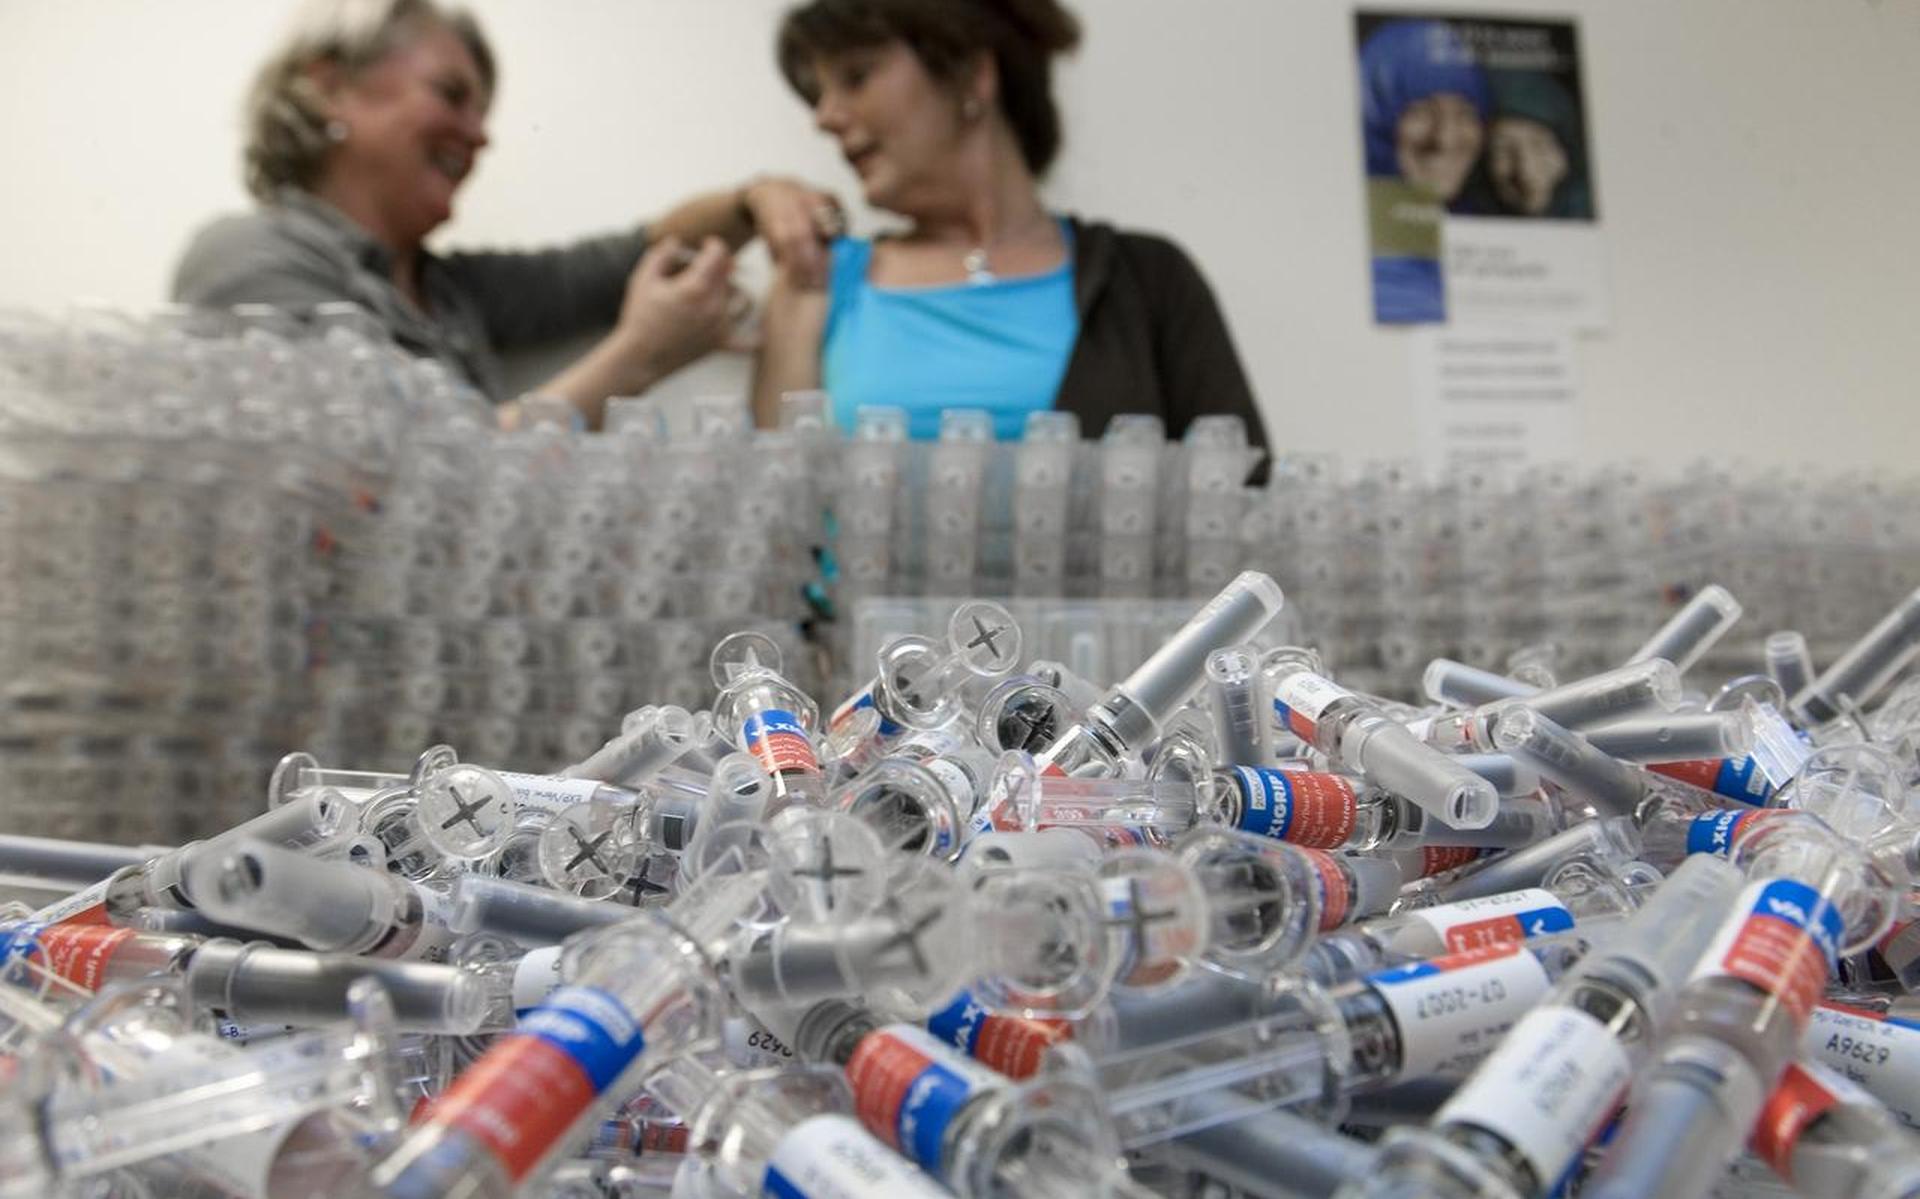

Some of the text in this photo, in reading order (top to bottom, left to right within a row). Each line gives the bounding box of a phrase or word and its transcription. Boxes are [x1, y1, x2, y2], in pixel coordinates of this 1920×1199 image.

[1266, 774, 1287, 839] XIGRIP
[748, 1031, 793, 1057] 9629
[1825, 1033, 1890, 1065] A9629
